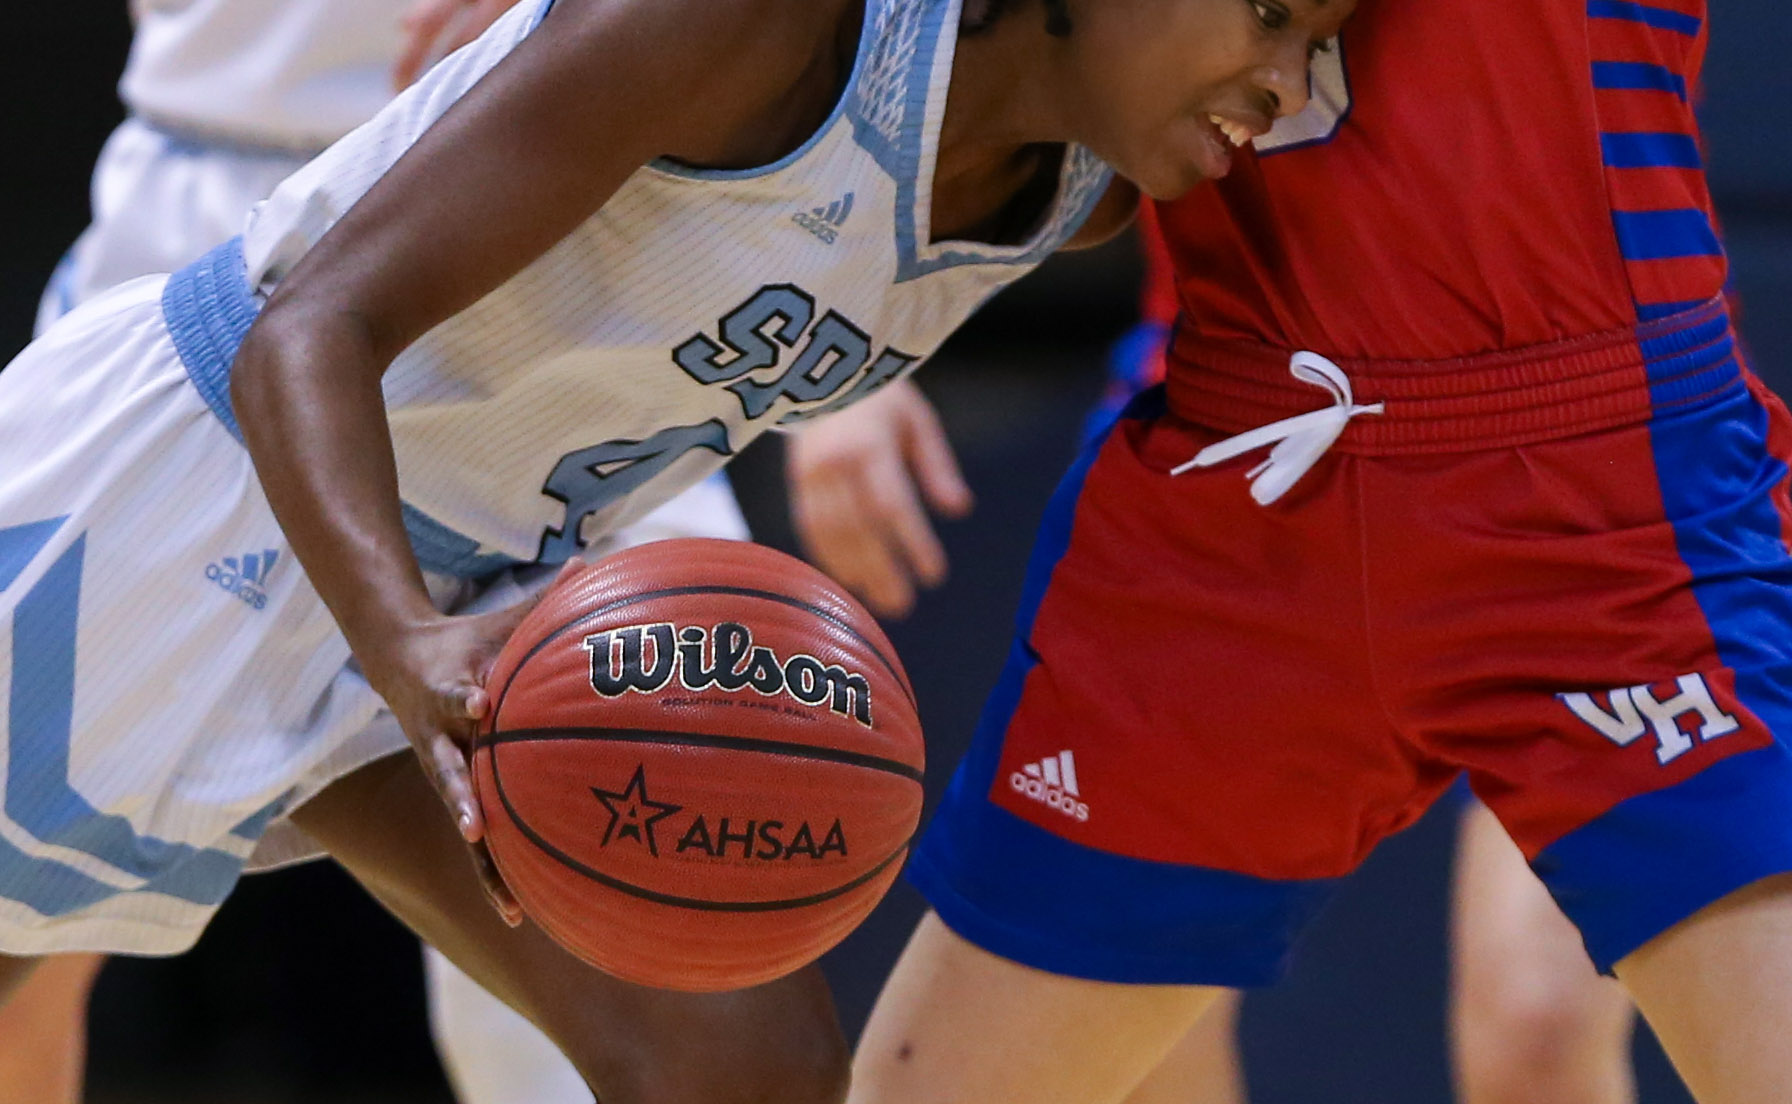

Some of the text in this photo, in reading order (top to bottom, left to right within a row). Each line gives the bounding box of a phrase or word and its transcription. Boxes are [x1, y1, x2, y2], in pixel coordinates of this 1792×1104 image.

[582, 621, 873, 730] Wilson
[1009, 771, 1090, 823] adidas
[676, 814, 849, 861] AHSAA
